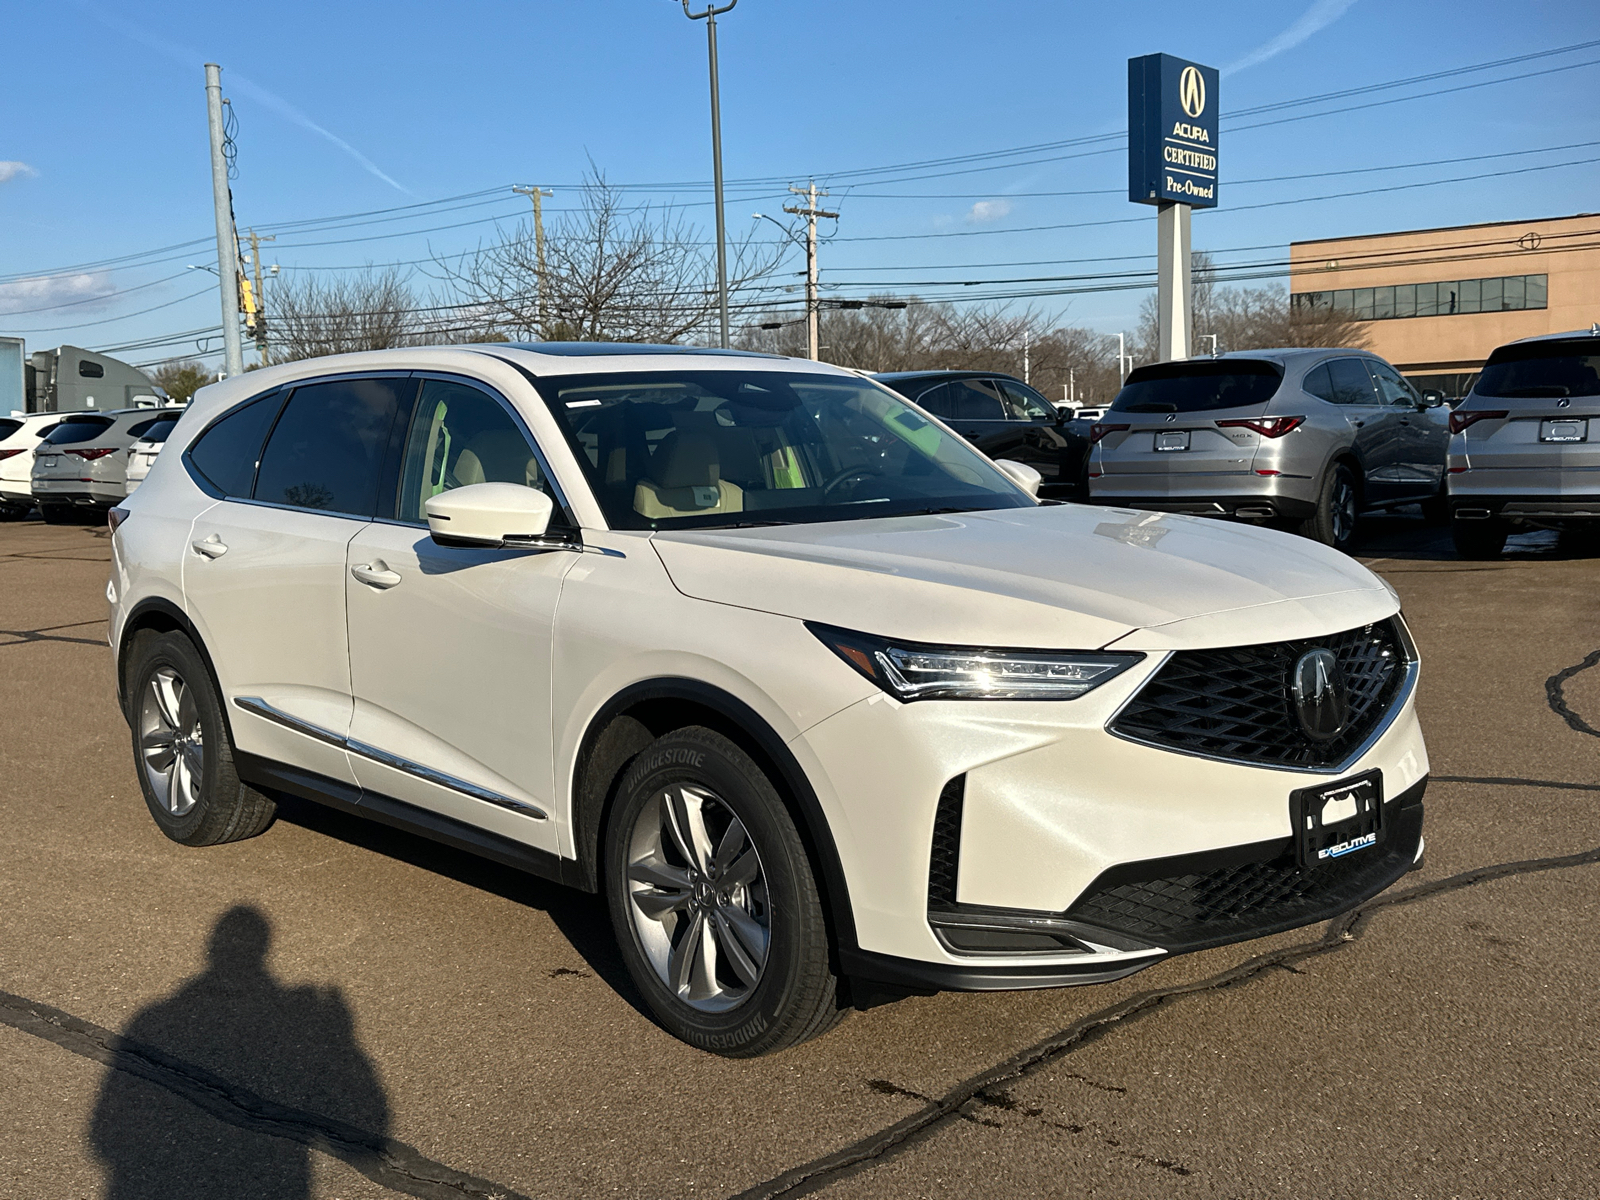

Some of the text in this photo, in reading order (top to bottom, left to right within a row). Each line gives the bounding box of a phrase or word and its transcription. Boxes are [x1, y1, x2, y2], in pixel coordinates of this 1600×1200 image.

[1173, 121, 1209, 143] ACURA
[1164, 145, 1216, 171] CERTIFIED
[1166, 175, 1213, 199] Pre-Owned
[1318, 832, 1376, 859] EXECUTIVE
